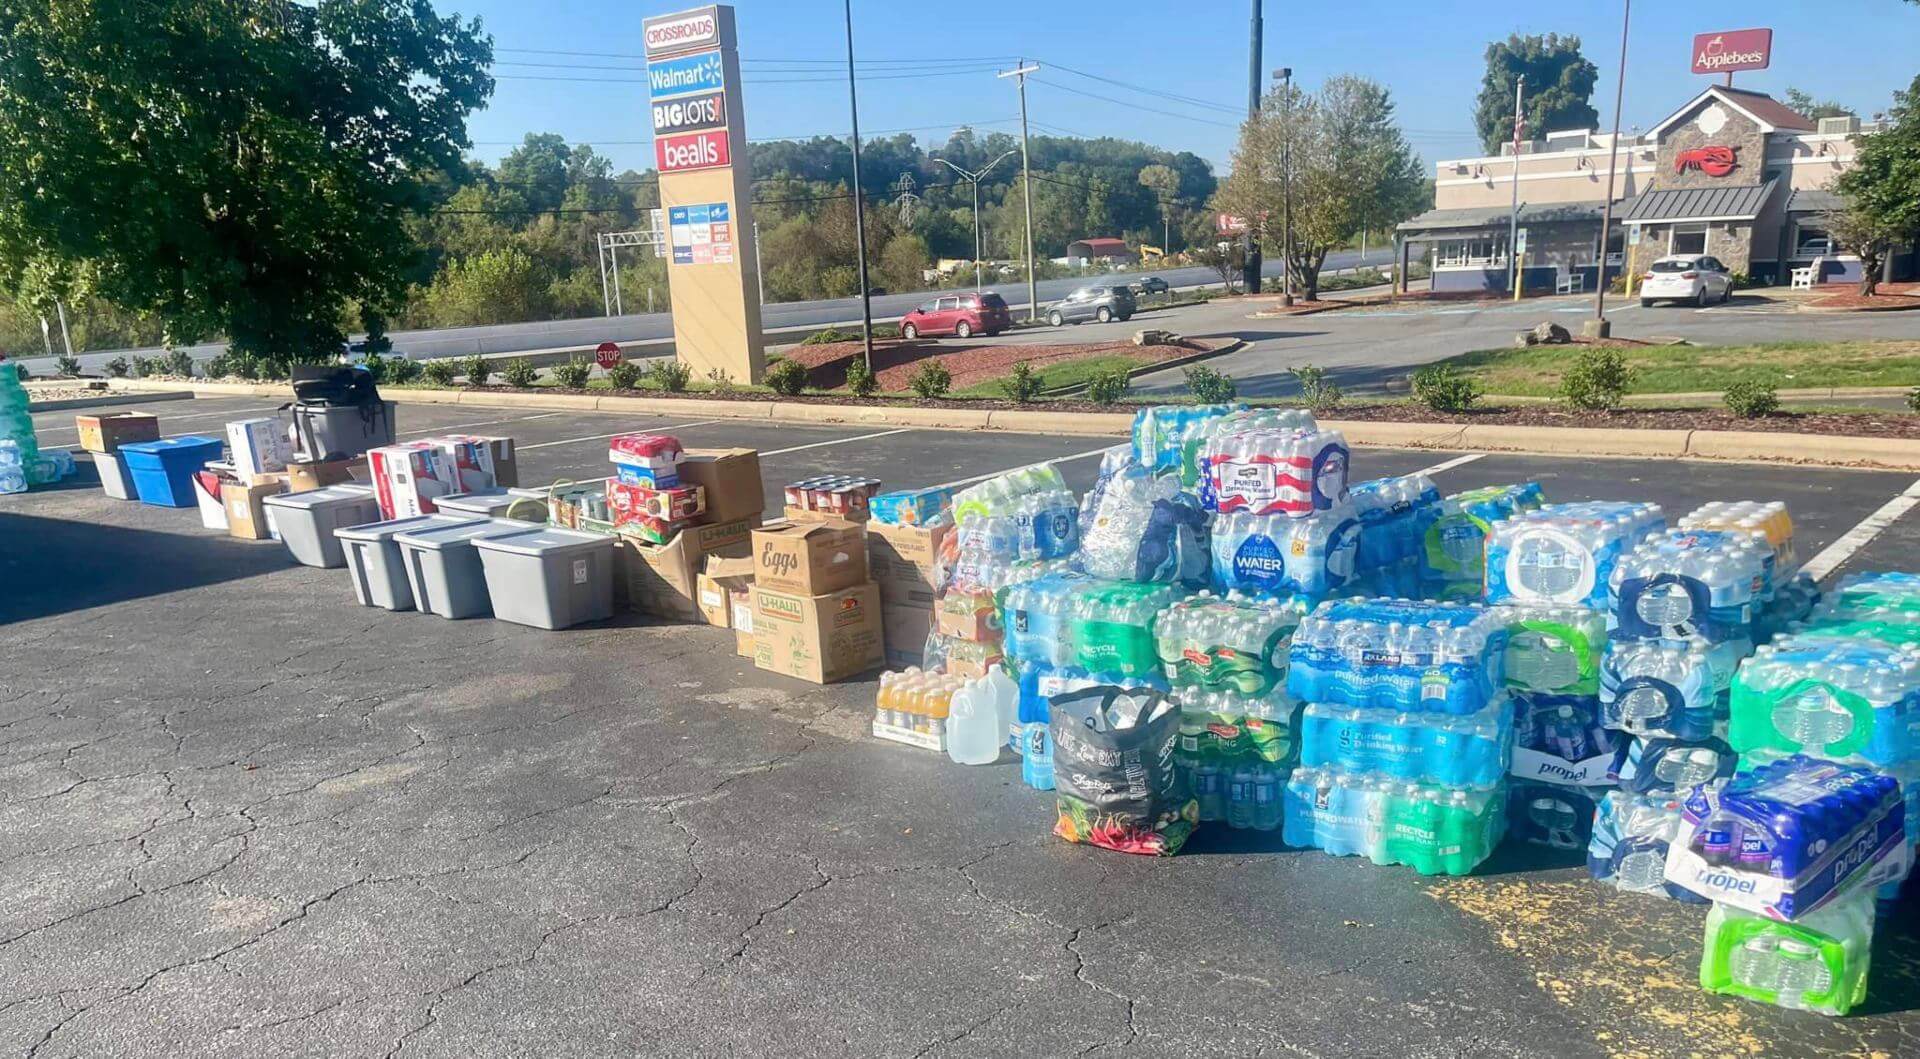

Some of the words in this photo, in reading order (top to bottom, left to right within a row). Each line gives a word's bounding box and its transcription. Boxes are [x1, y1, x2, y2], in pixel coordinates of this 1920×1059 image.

[647, 19, 713, 44] CROSSROADS
[1696, 51, 1762, 68] Applebee's
[650, 63, 704, 90] Walmart
[664, 135, 718, 167] bealls
[597, 350, 620, 361] STOP
[762, 541, 798, 577] Eggs
[1236, 556, 1282, 571] WATER
[760, 595, 801, 614] U-HAUL
[1537, 761, 1589, 782] propel
[1395, 824, 1435, 839] RECYCLE
[1834, 822, 1879, 884] propel
[1696, 869, 1757, 894] propel
